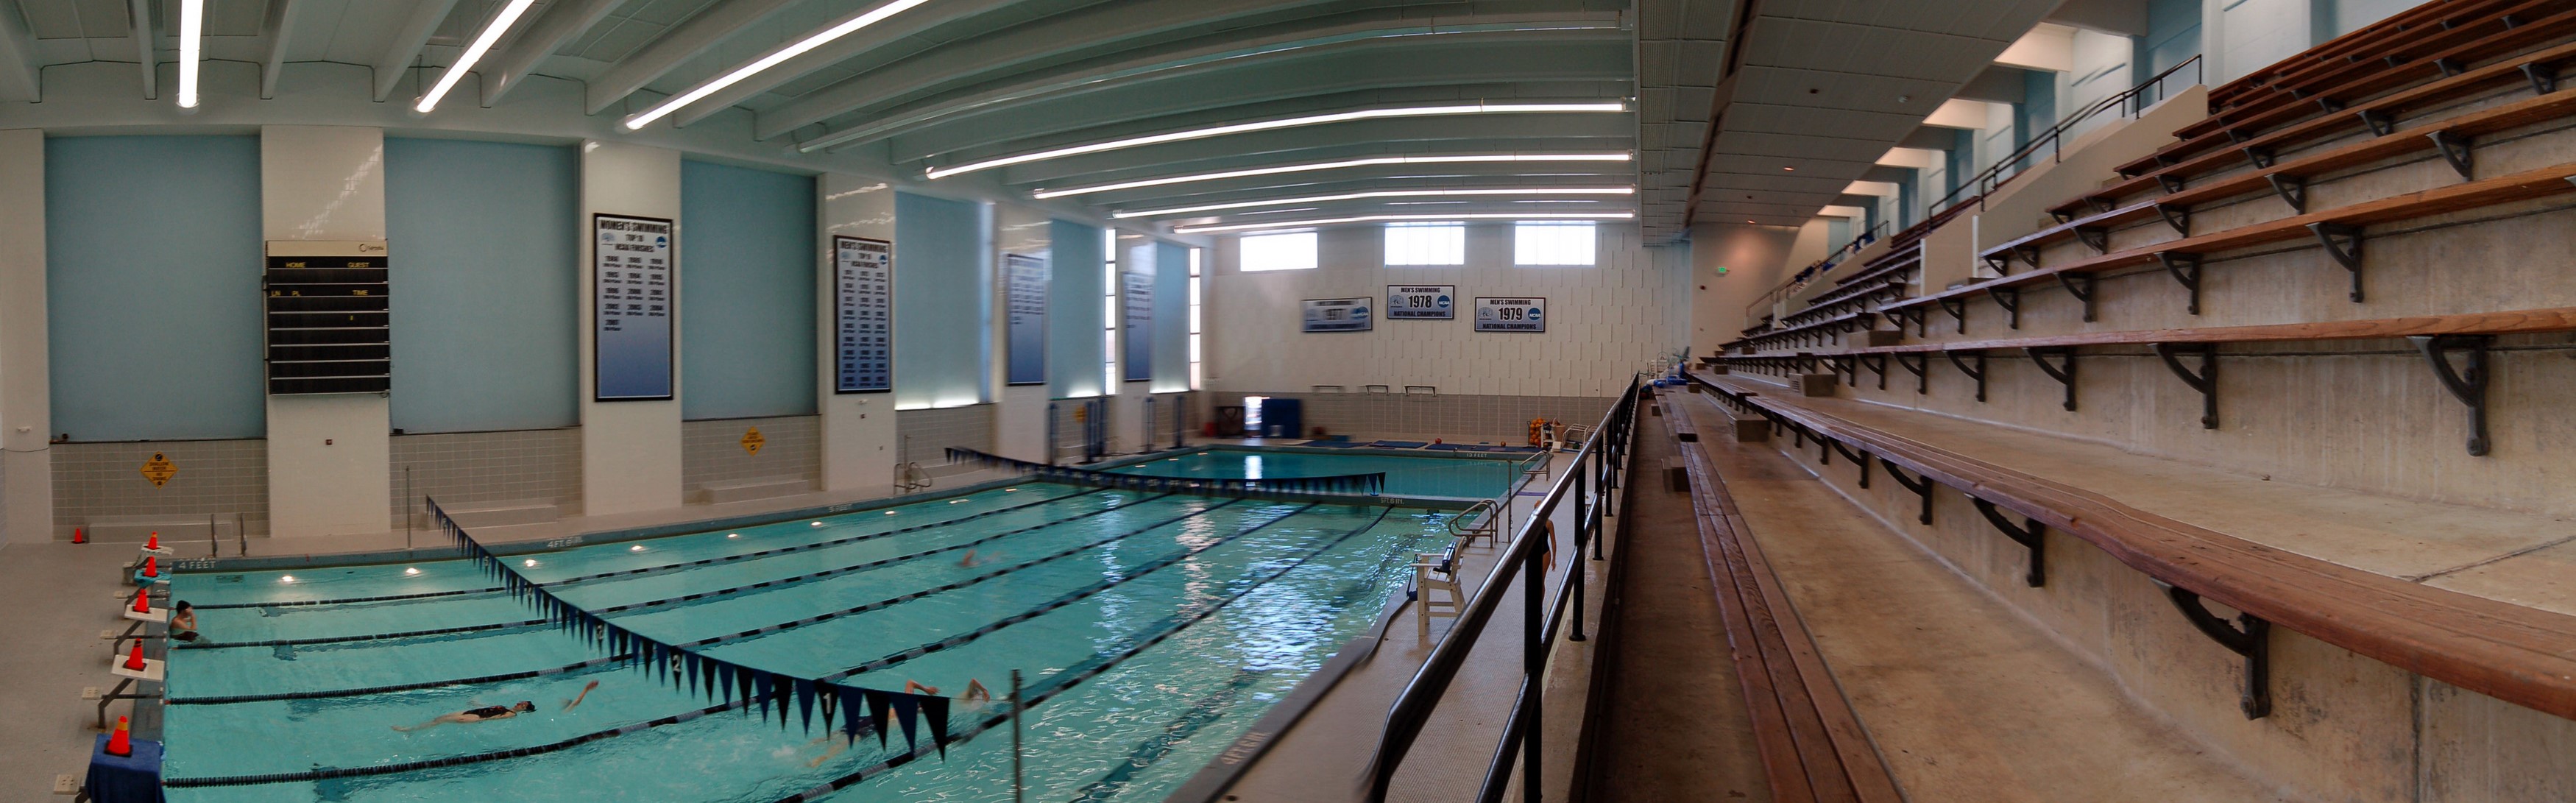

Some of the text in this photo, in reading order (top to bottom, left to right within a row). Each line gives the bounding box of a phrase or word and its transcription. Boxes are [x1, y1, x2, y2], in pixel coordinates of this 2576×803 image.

[600, 220, 668, 234] WOMEN'S SWIMMING
[1408, 295, 1432, 308] 1978
[1498, 307, 1523, 320] 1979
[179, 561, 216, 570] 4 FEET
[672, 654, 682, 673] 2
[823, 692, 832, 715] 1
